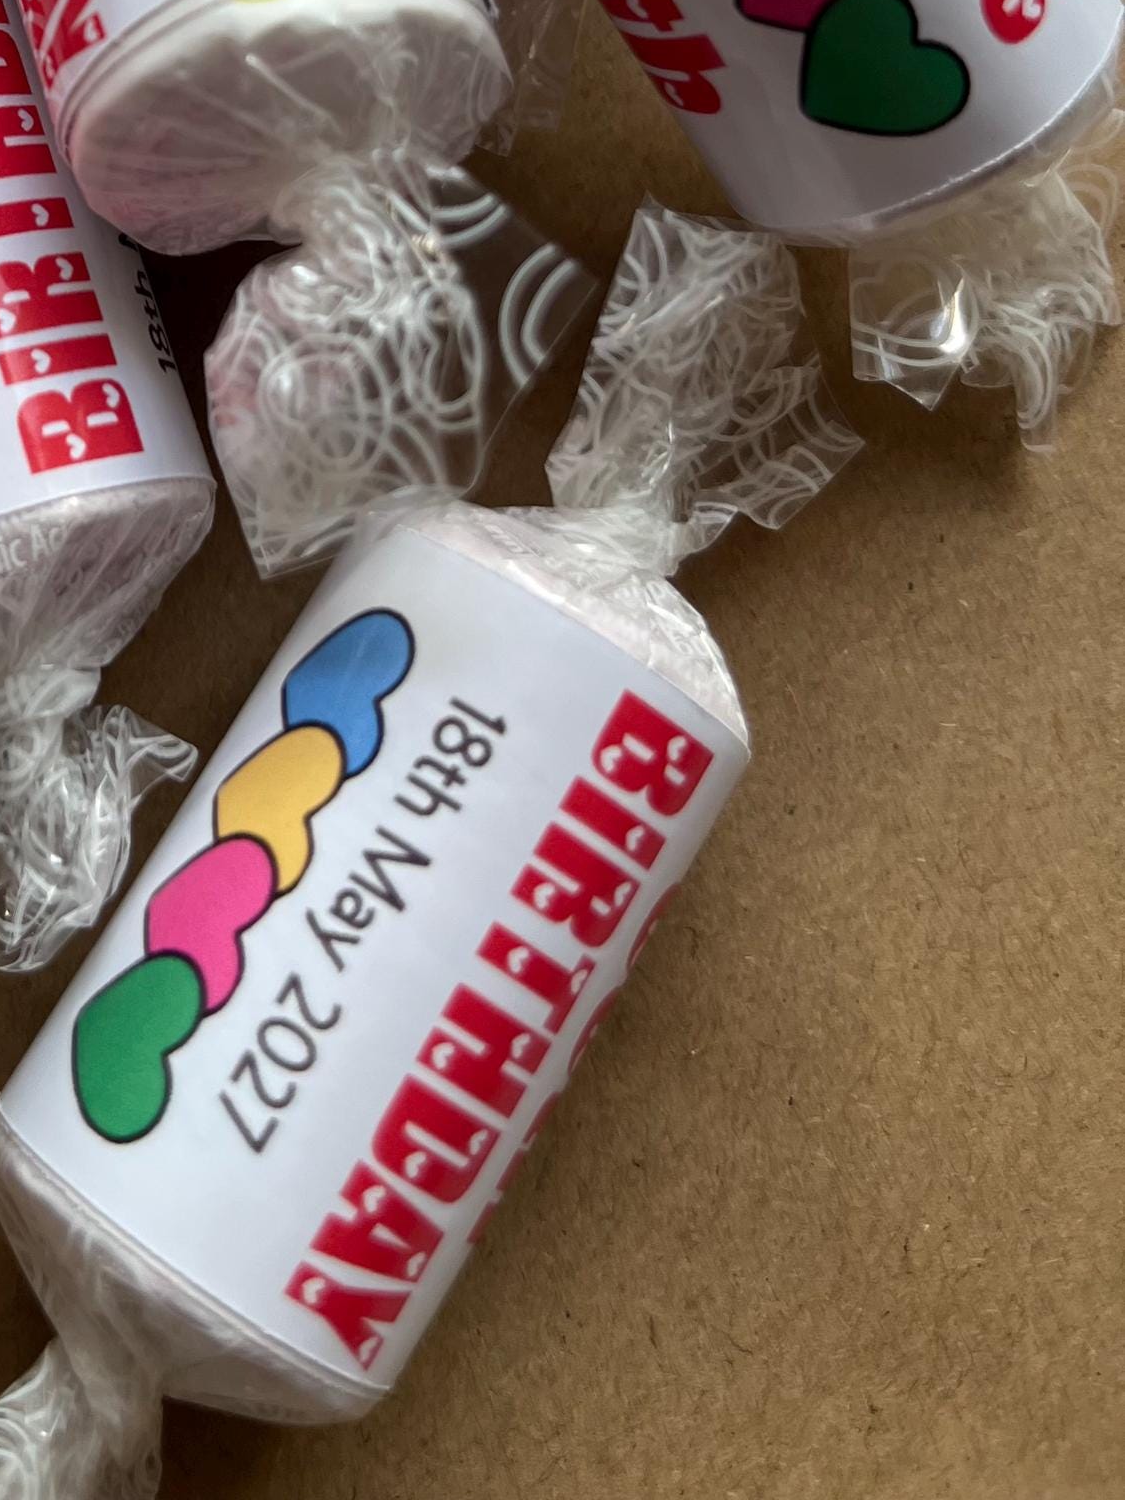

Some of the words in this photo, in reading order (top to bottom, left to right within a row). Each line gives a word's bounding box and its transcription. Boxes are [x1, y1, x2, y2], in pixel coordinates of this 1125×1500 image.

[392, 695, 508, 817] 18th
[305, 825, 432, 973] May
[219, 971, 343, 1155] 2027
[284, 689, 715, 1372] BIRTHDAY
